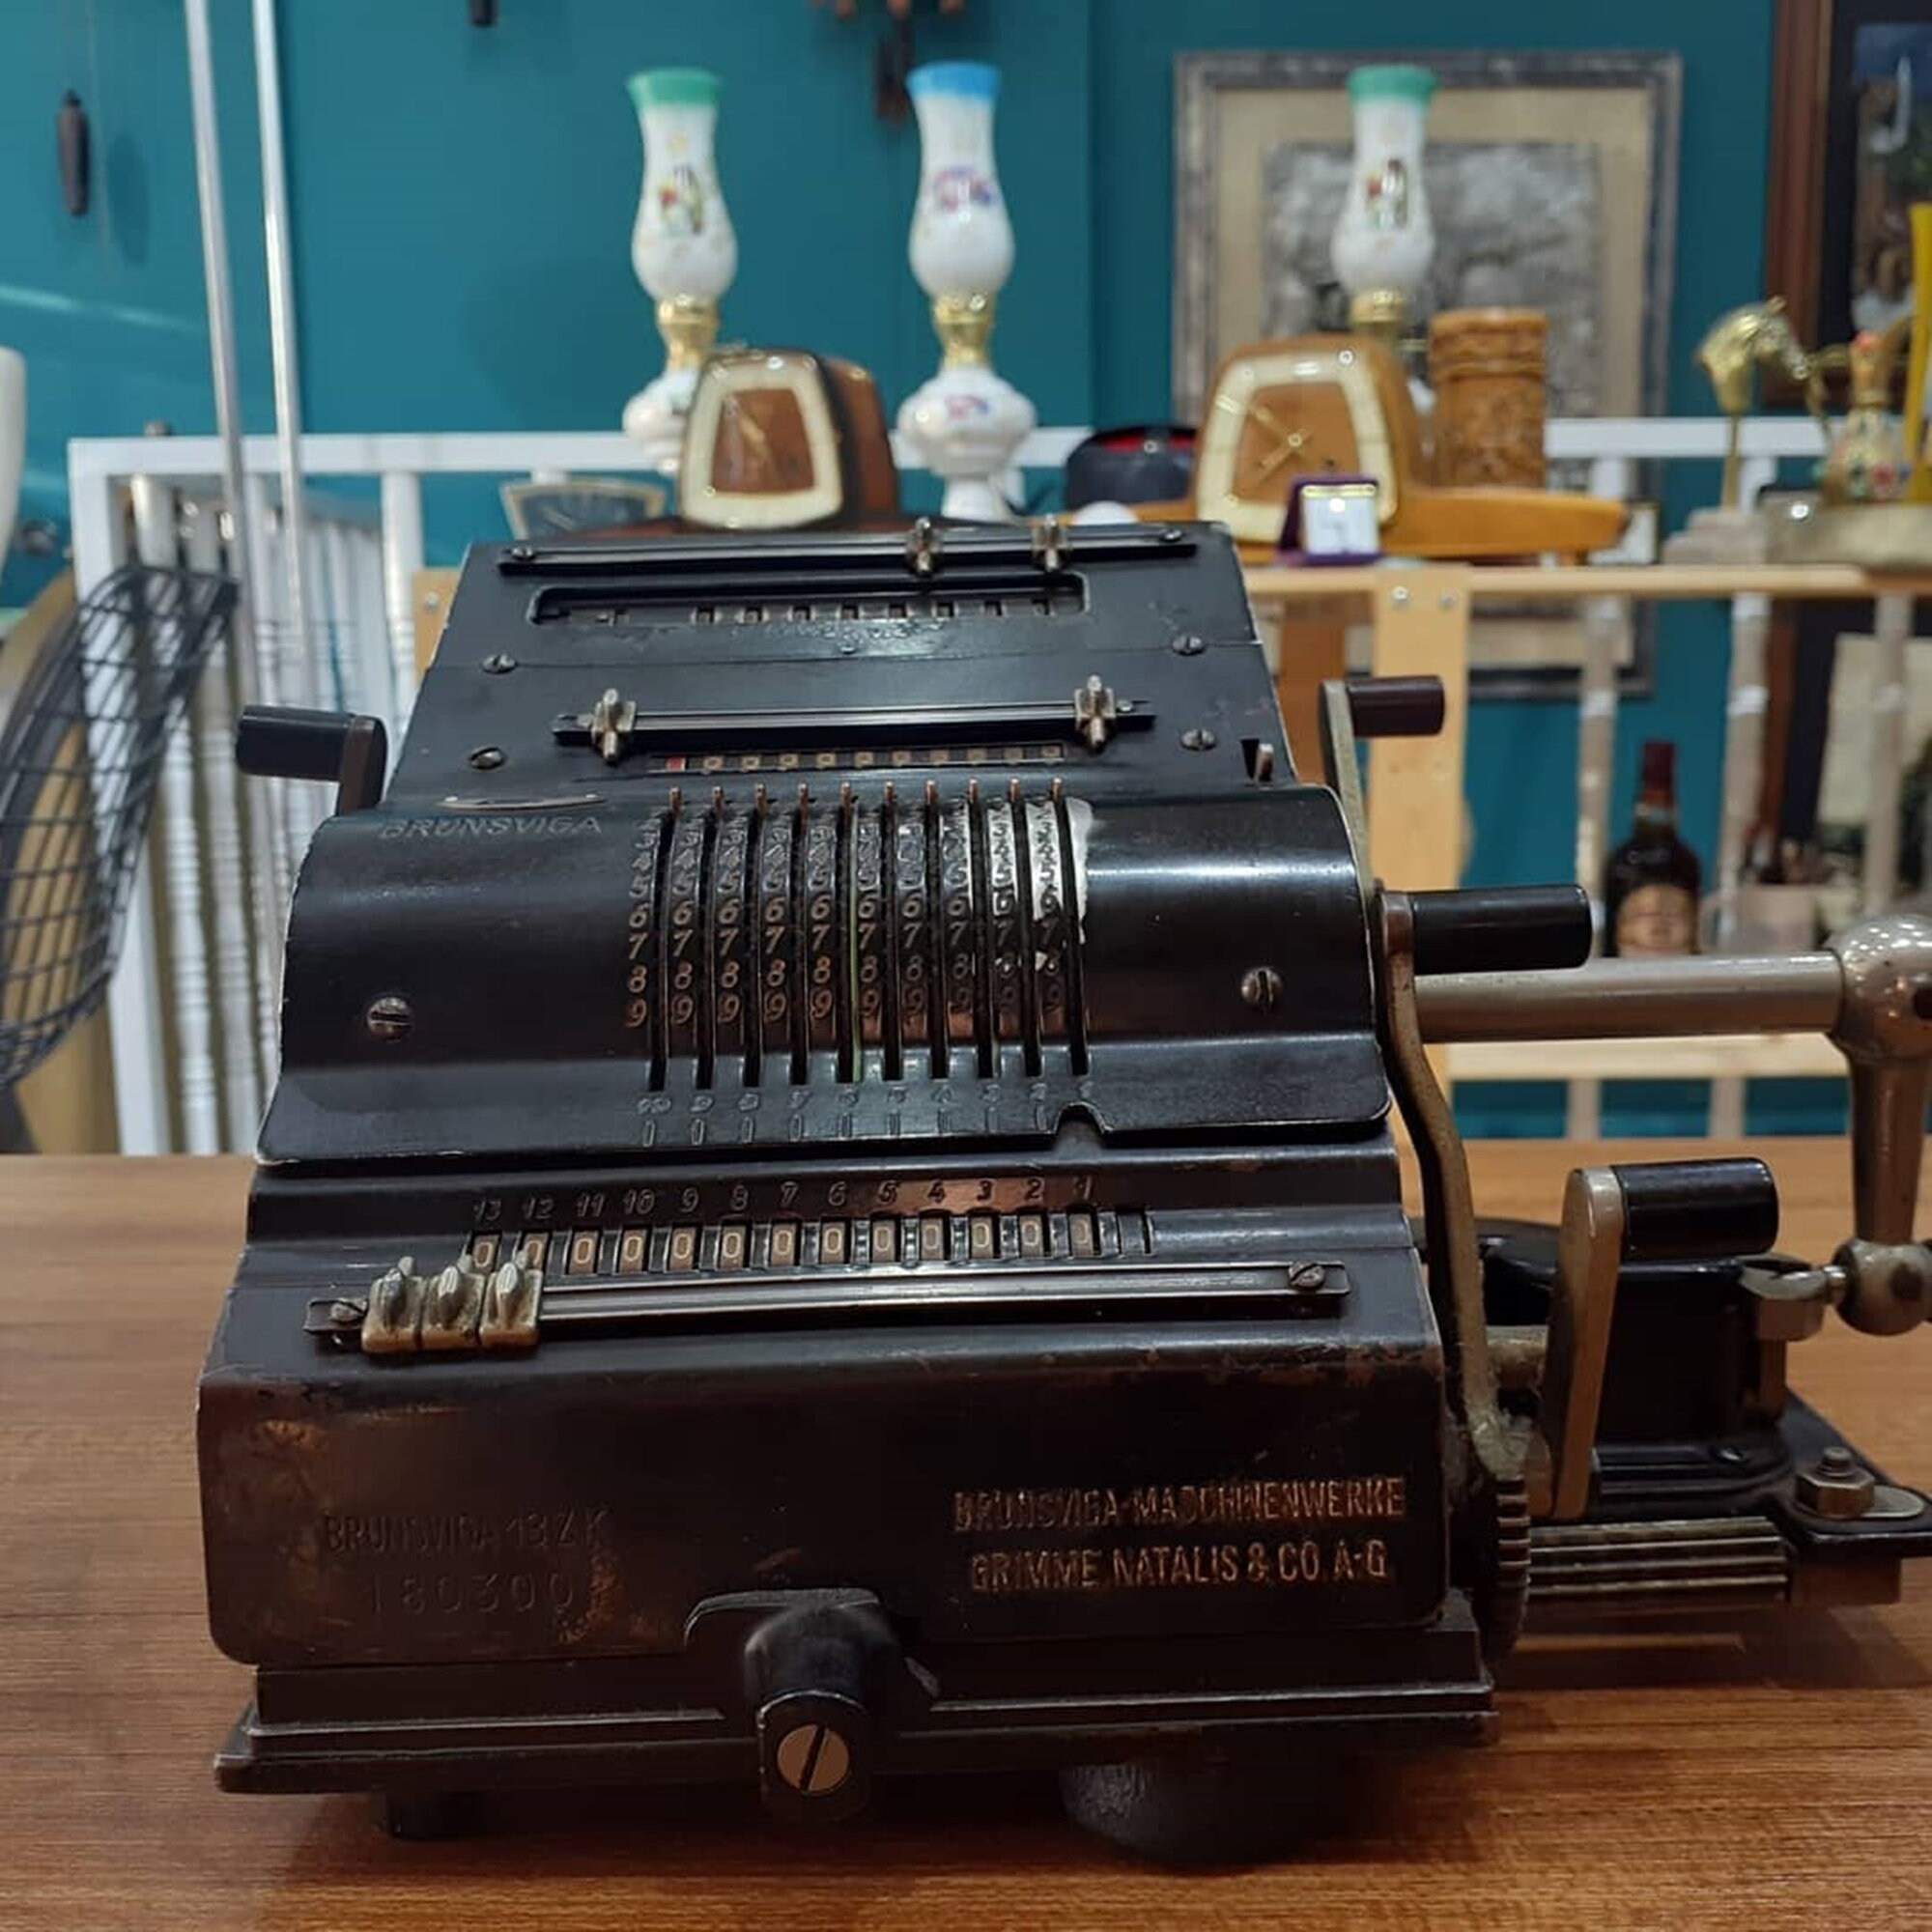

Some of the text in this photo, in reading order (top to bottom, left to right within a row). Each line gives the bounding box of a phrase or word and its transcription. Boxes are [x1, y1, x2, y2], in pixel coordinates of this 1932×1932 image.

[379, 816, 601, 839] BRUNSVIGA
[629, 902, 649, 928] 6
[673, 900, 694, 925] 6
[718, 897, 739, 924] 6
[765, 896, 785, 923] 6
[811, 895, 831, 920] 6
[858, 893, 879, 919] 6
[901, 893, 922, 918] 6
[948, 892, 969, 916] 6
[1040, 885, 1059, 913] 6
[629, 931, 648, 959] 7
[673, 928, 694, 956] 7
[718, 927, 739, 955] 7
[765, 925, 785, 954] 7
[811, 923, 831, 951] 7
[858, 923, 877, 950] 7
[903, 922, 922, 948] 7
[950, 921, 968, 946] 7
[629, 965, 647, 993] 8
[674, 960, 694, 989] 8
[722, 960, 740, 988] 8
[767, 958, 786, 986] 8
[813, 955, 831, 983] 8
[860, 954, 878, 982] 8
[906, 955, 923, 981] 8
[953, 952, 969, 980] 8
[626, 998, 647, 1027] 9
[671, 993, 694, 1024] 9
[717, 992, 740, 1023] 9
[763, 990, 786, 1023] 9
[810, 987, 832, 1018] 9
[860, 987, 878, 1016] 9
[473, 1175, 1093, 1220] 13 12 11 10 9 8 7 6 5 4 3 2 1
[571, 1237, 594, 1264] 0
[626, 1236, 643, 1262] 0
[674, 1233, 691, 1259] 0
[724, 1233, 741, 1258] 0
[775, 1230, 793, 1255] 0
[826, 1228, 842, 1254] 0
[874, 1225, 891, 1252] 0
[924, 1224, 940, 1250] 0
[972, 1223, 989, 1248] 0
[1021, 1220, 1037, 1246] 0
[1070, 1221, 1088, 1244] 0
[972, 1548, 1102, 1590] GRIMME
[1112, 1543, 1238, 1587] NATALIS
[1248, 1542, 1265, 1582] &
